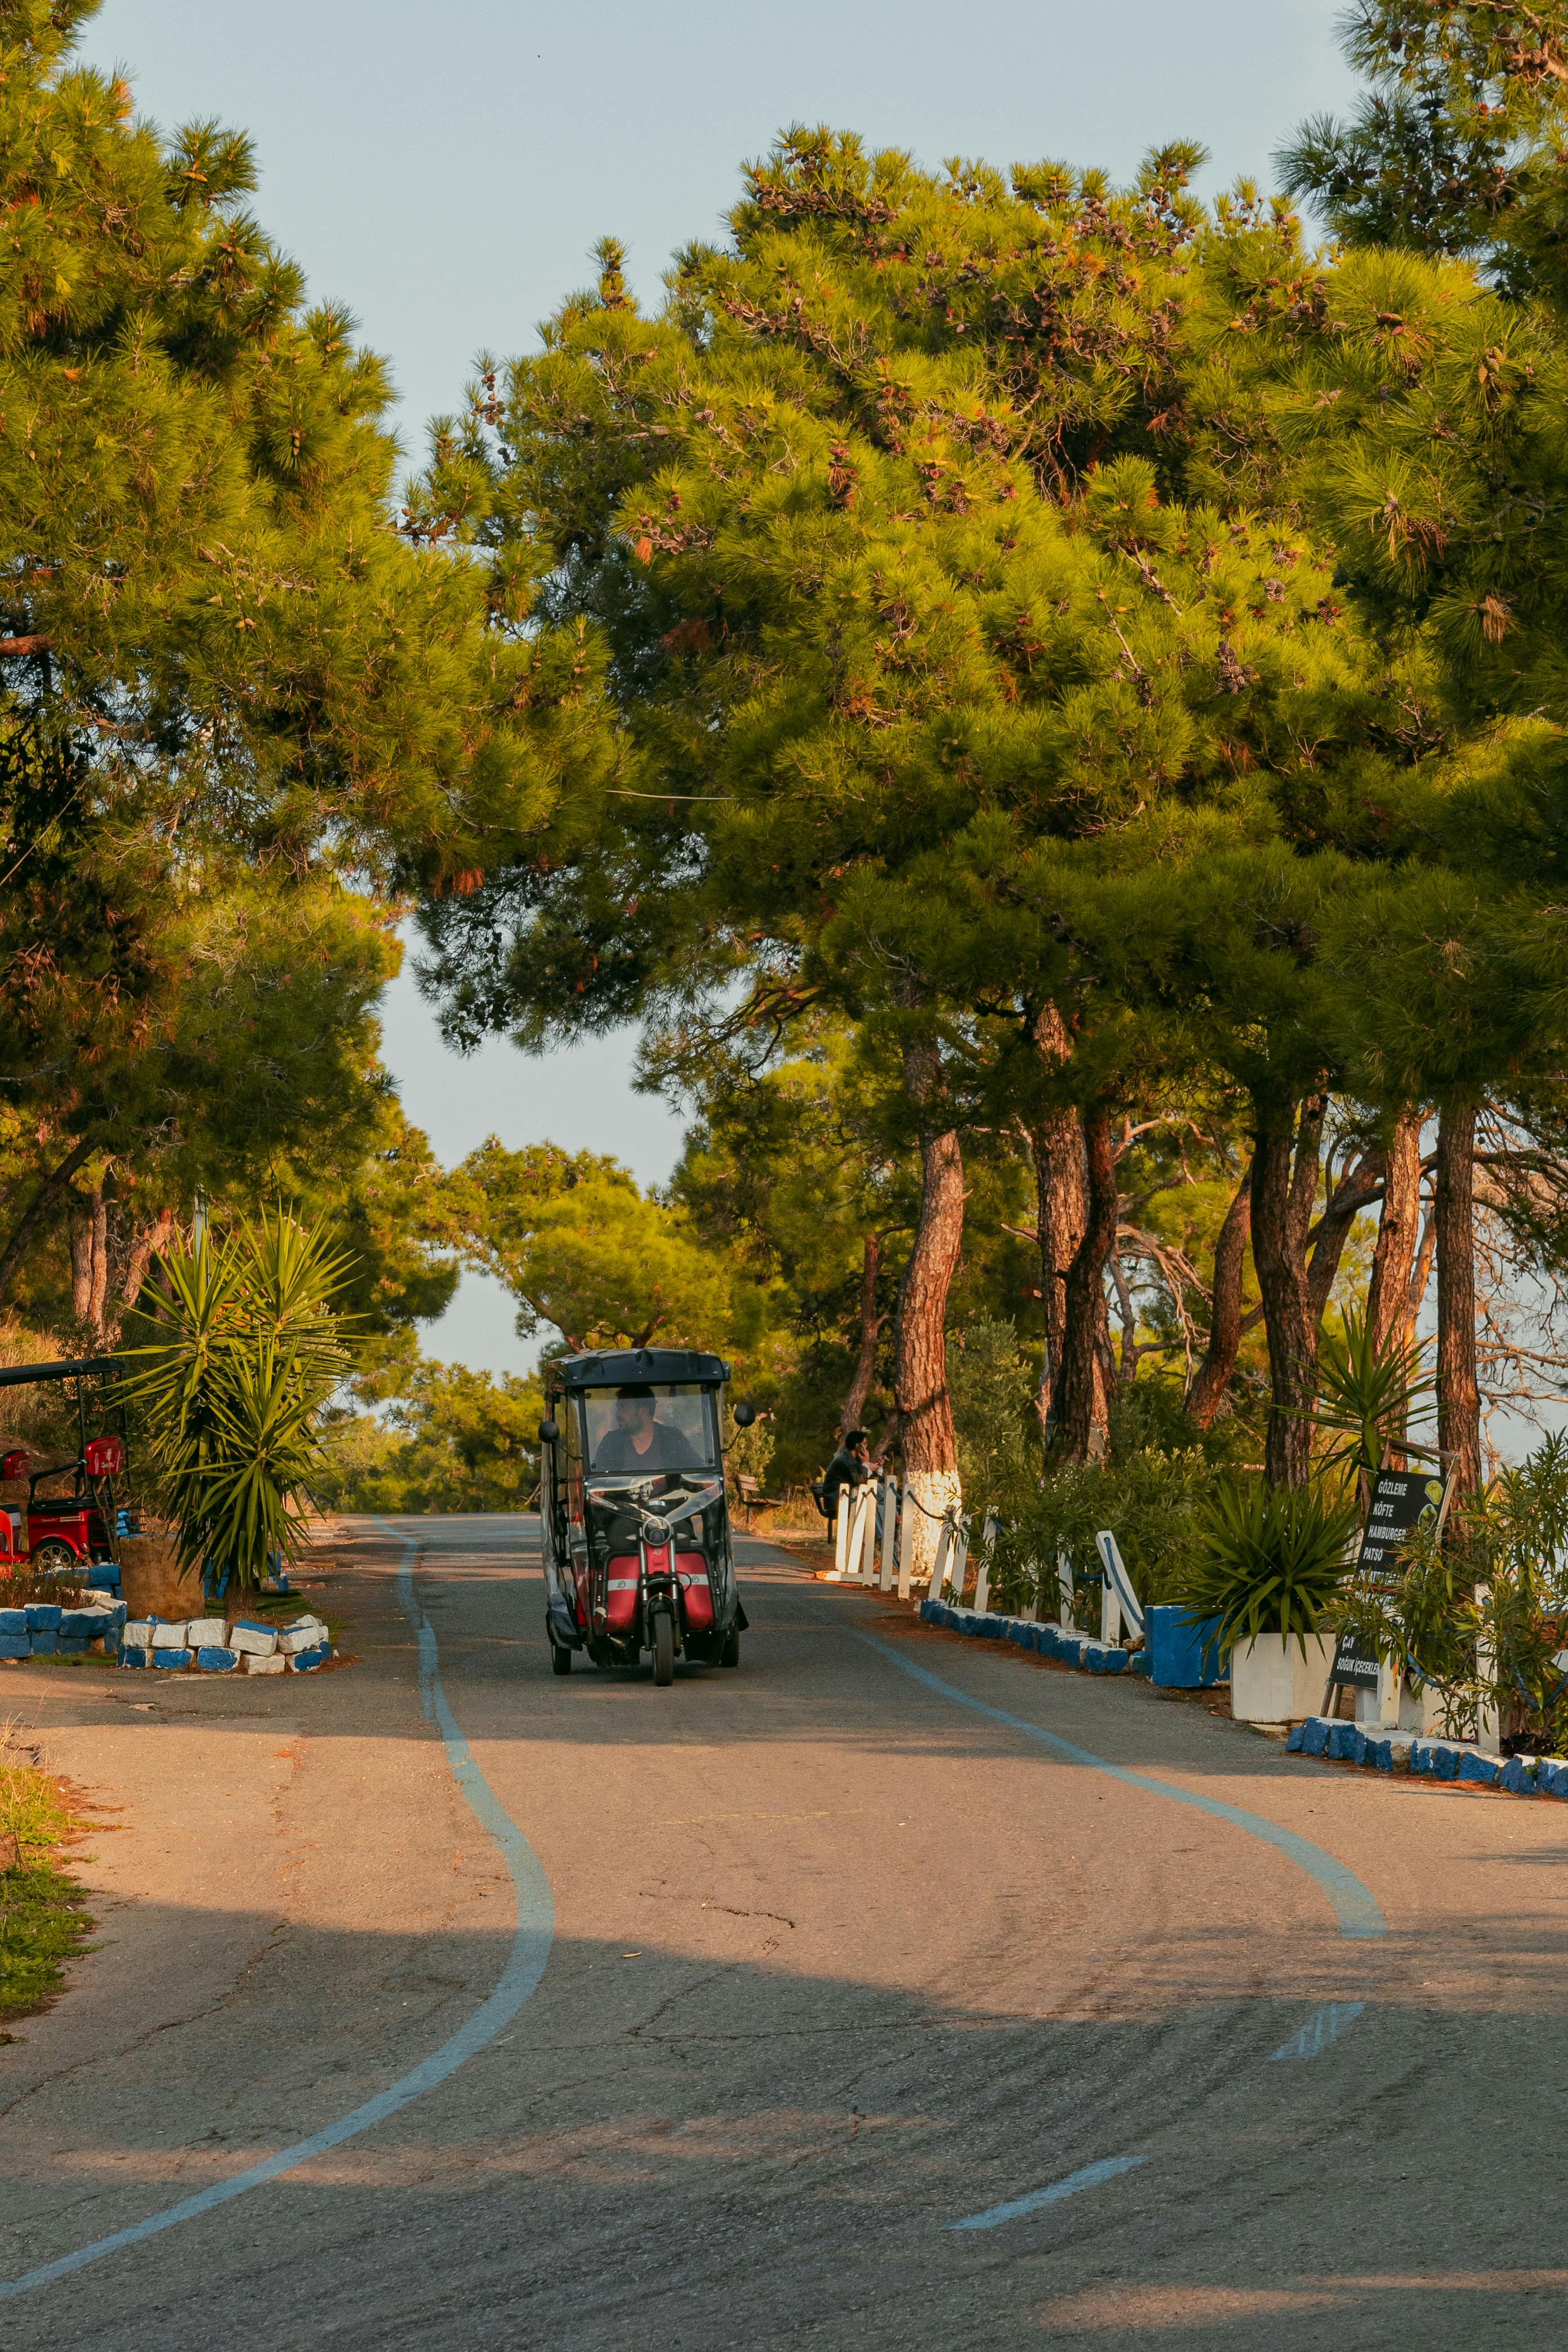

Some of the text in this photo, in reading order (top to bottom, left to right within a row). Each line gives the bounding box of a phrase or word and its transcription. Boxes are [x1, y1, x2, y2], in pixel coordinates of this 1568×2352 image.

[1378, 1479, 1407, 1496] GÖZLEME
[1373, 1501, 1395, 1517] KÖFTE
[1368, 1525, 1406, 1541] HAMBURGER
[1363, 1547, 1383, 1561] PATSO
[1342, 1635, 1356, 1651] ÇAY
[1337, 1656, 1355, 1672] SOĞUK
